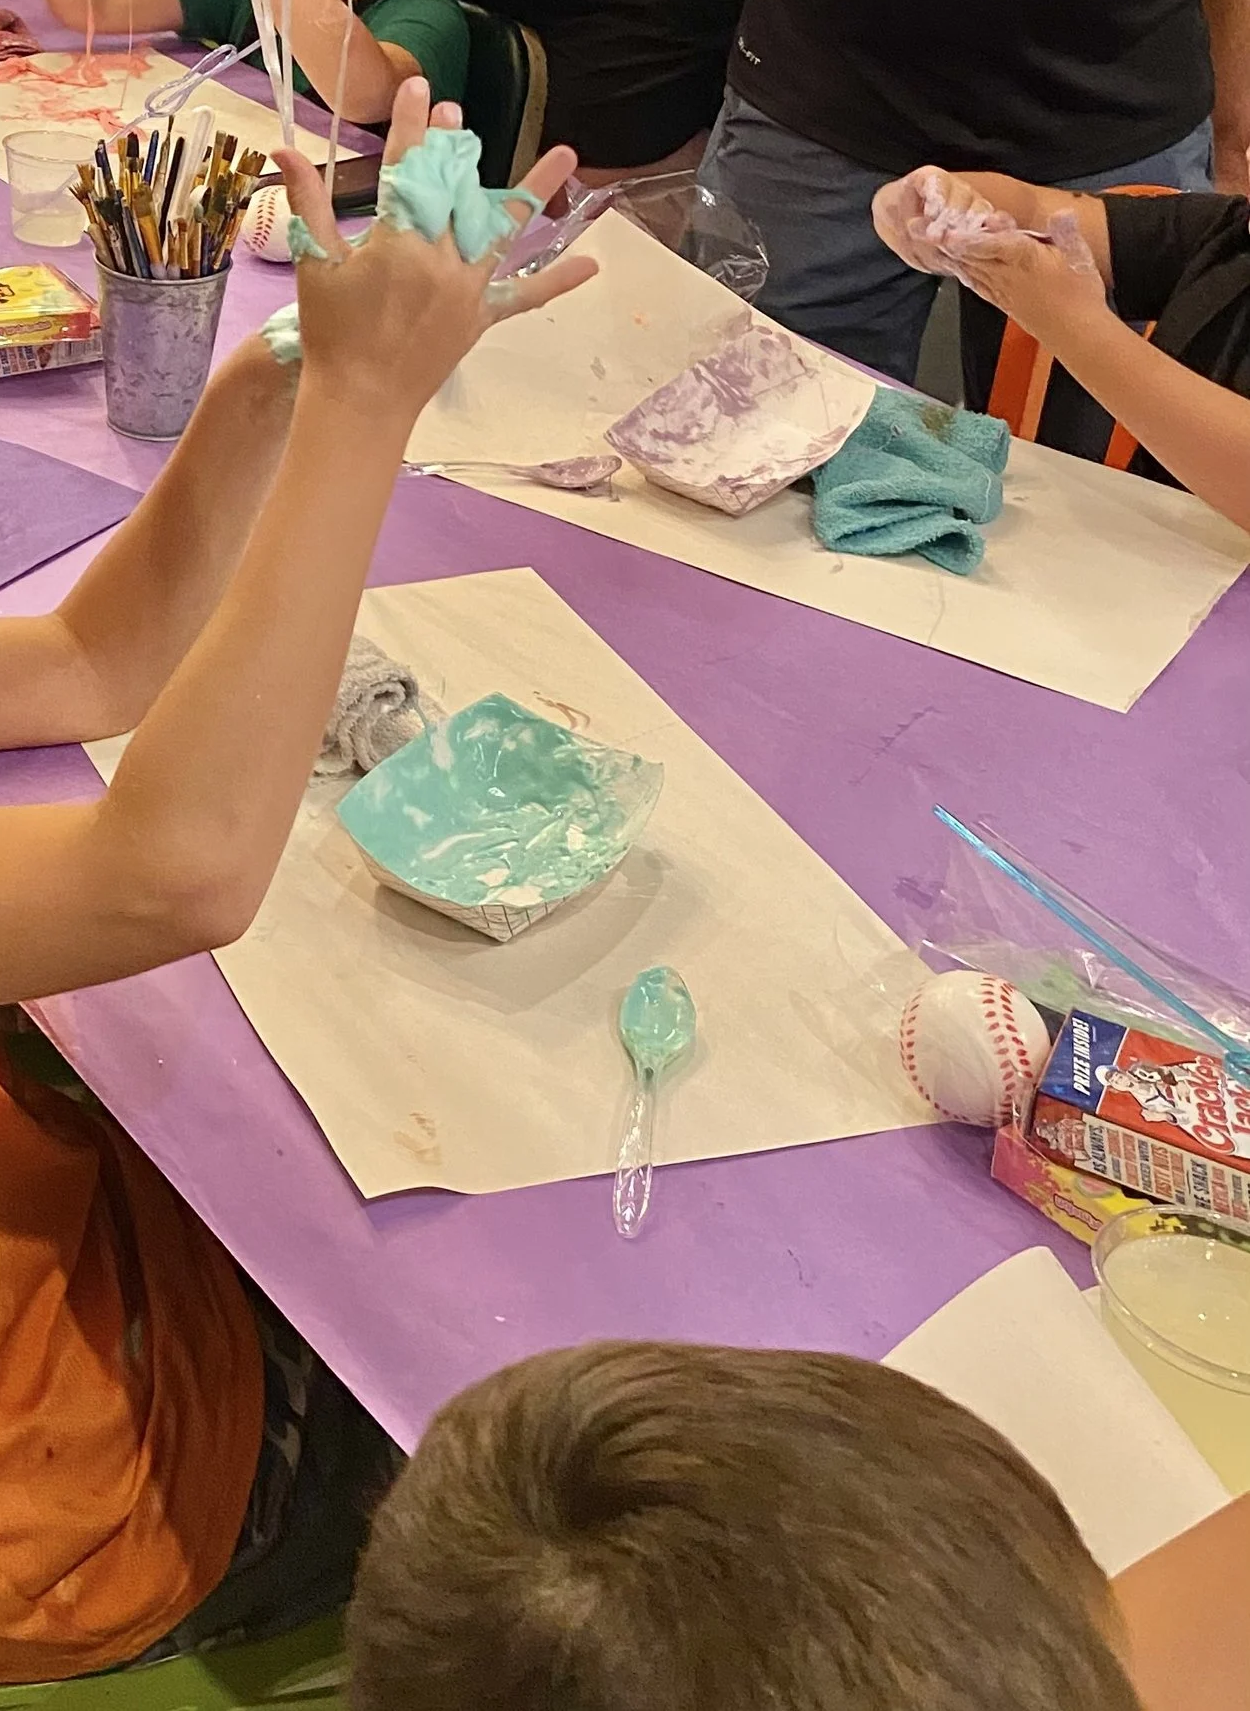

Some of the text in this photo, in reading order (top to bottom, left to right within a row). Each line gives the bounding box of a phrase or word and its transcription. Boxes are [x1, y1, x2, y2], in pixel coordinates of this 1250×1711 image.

[1072, 1017, 1091, 1096] PRIZE INSIDE!
[1185, 1055, 1236, 1155] Cracker
